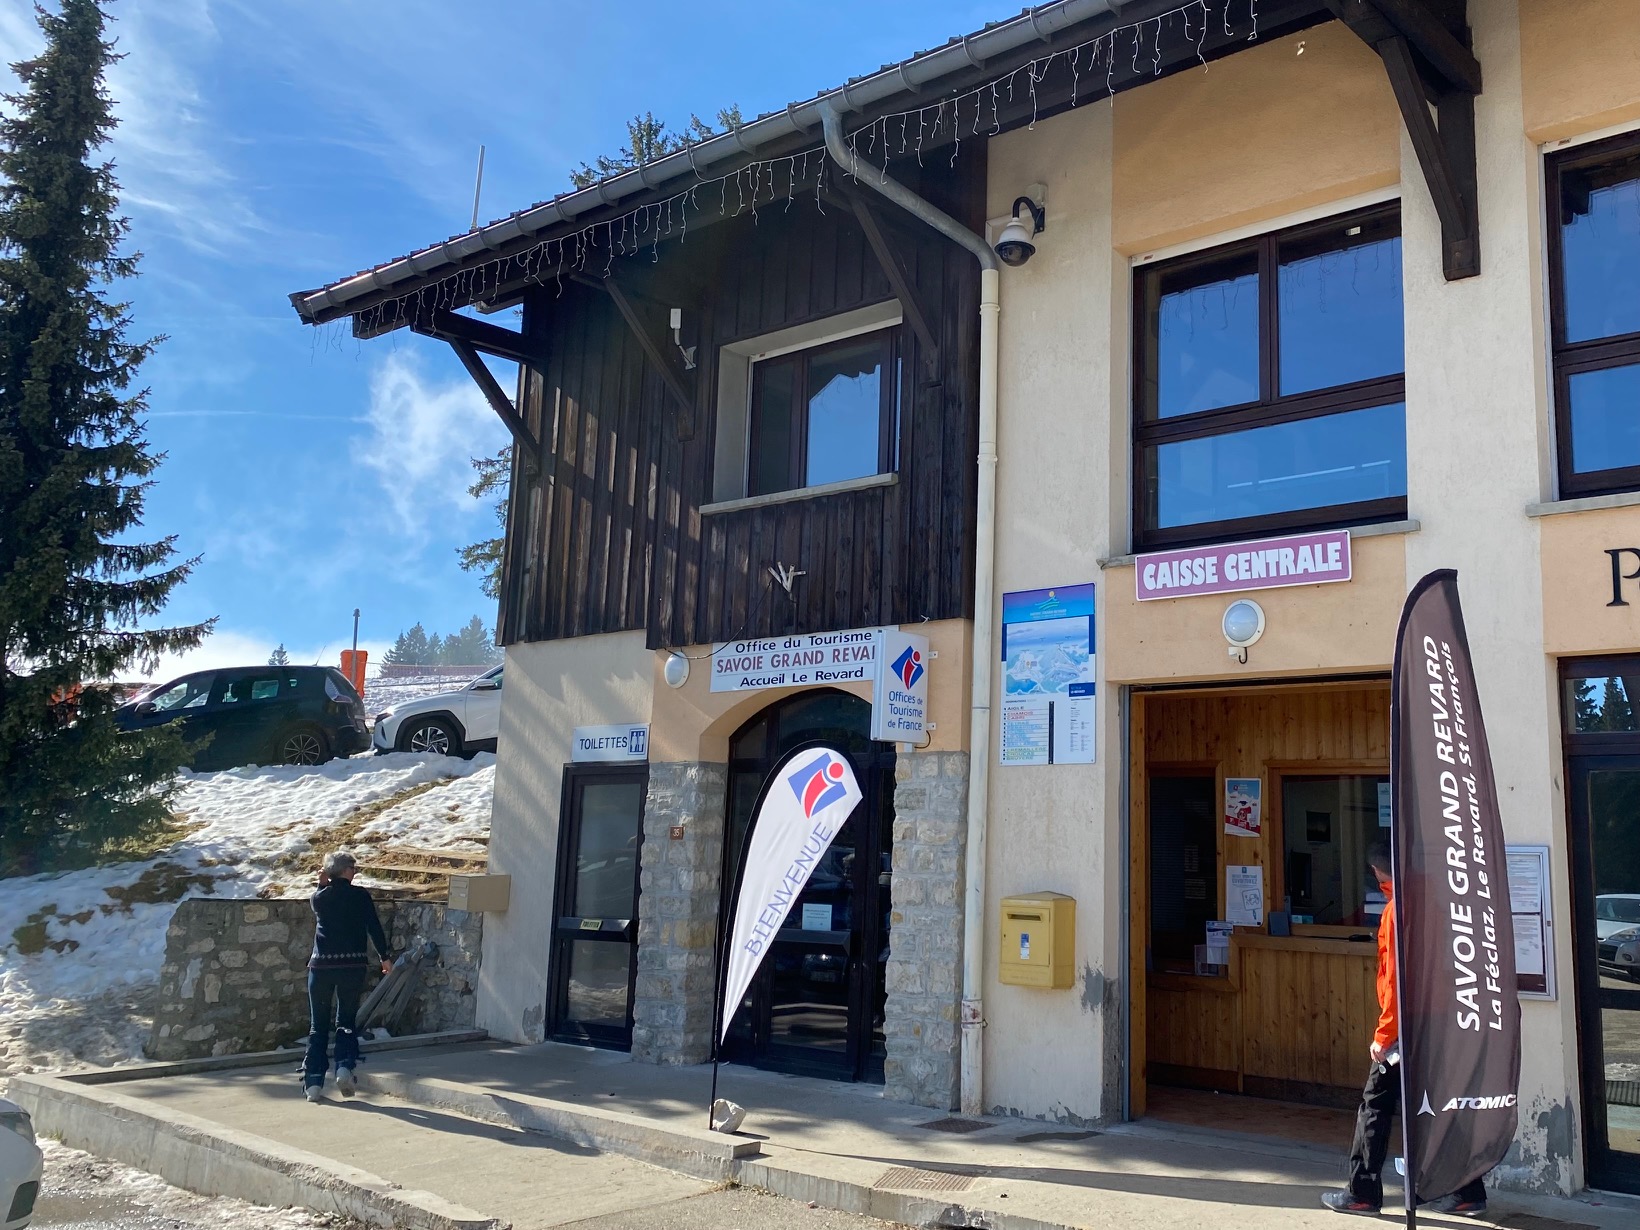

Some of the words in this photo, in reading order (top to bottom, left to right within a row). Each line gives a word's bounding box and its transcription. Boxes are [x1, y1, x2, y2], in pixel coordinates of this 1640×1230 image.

[1143, 556, 1218, 590] CAISSE
[1224, 541, 1342, 582] CENTRALE
[1603, 548, 1640, 607] P
[735, 640, 776, 653] Office
[784, 637, 801, 649] du
[808, 632, 872, 646] Tourisme
[716, 655, 763, 673] SAVOIE
[770, 650, 824, 668] GRAND
[832, 645, 876, 663] REVA
[740, 673, 785, 687] Accueil
[792, 672, 808, 683] Le
[815, 666, 864, 681] Revard
[1441, 641, 1467, 738] François
[888, 690, 915, 704] Offices
[917, 697, 923, 705] de
[889, 703, 923, 718] Tourisme
[1423, 635, 1455, 765] REVARD
[887, 719, 896, 728] de
[897, 717, 922, 731] France
[579, 736, 628, 750] TOILETTES
[1459, 741, 1472, 767] St
[672, 828, 680, 837] 35
[1440, 771, 1470, 895] GRAND
[1462, 772, 1486, 866] Revard,
[744, 822, 833, 957] BIENVENUE
[1477, 870, 1491, 899] Le
[1481, 905, 1502, 994] Féclaz,
[1450, 902, 1480, 1032] SAVOIE
[1489, 1000, 1502, 1031] La
[1441, 1093, 1517, 1112] ATOMIC
